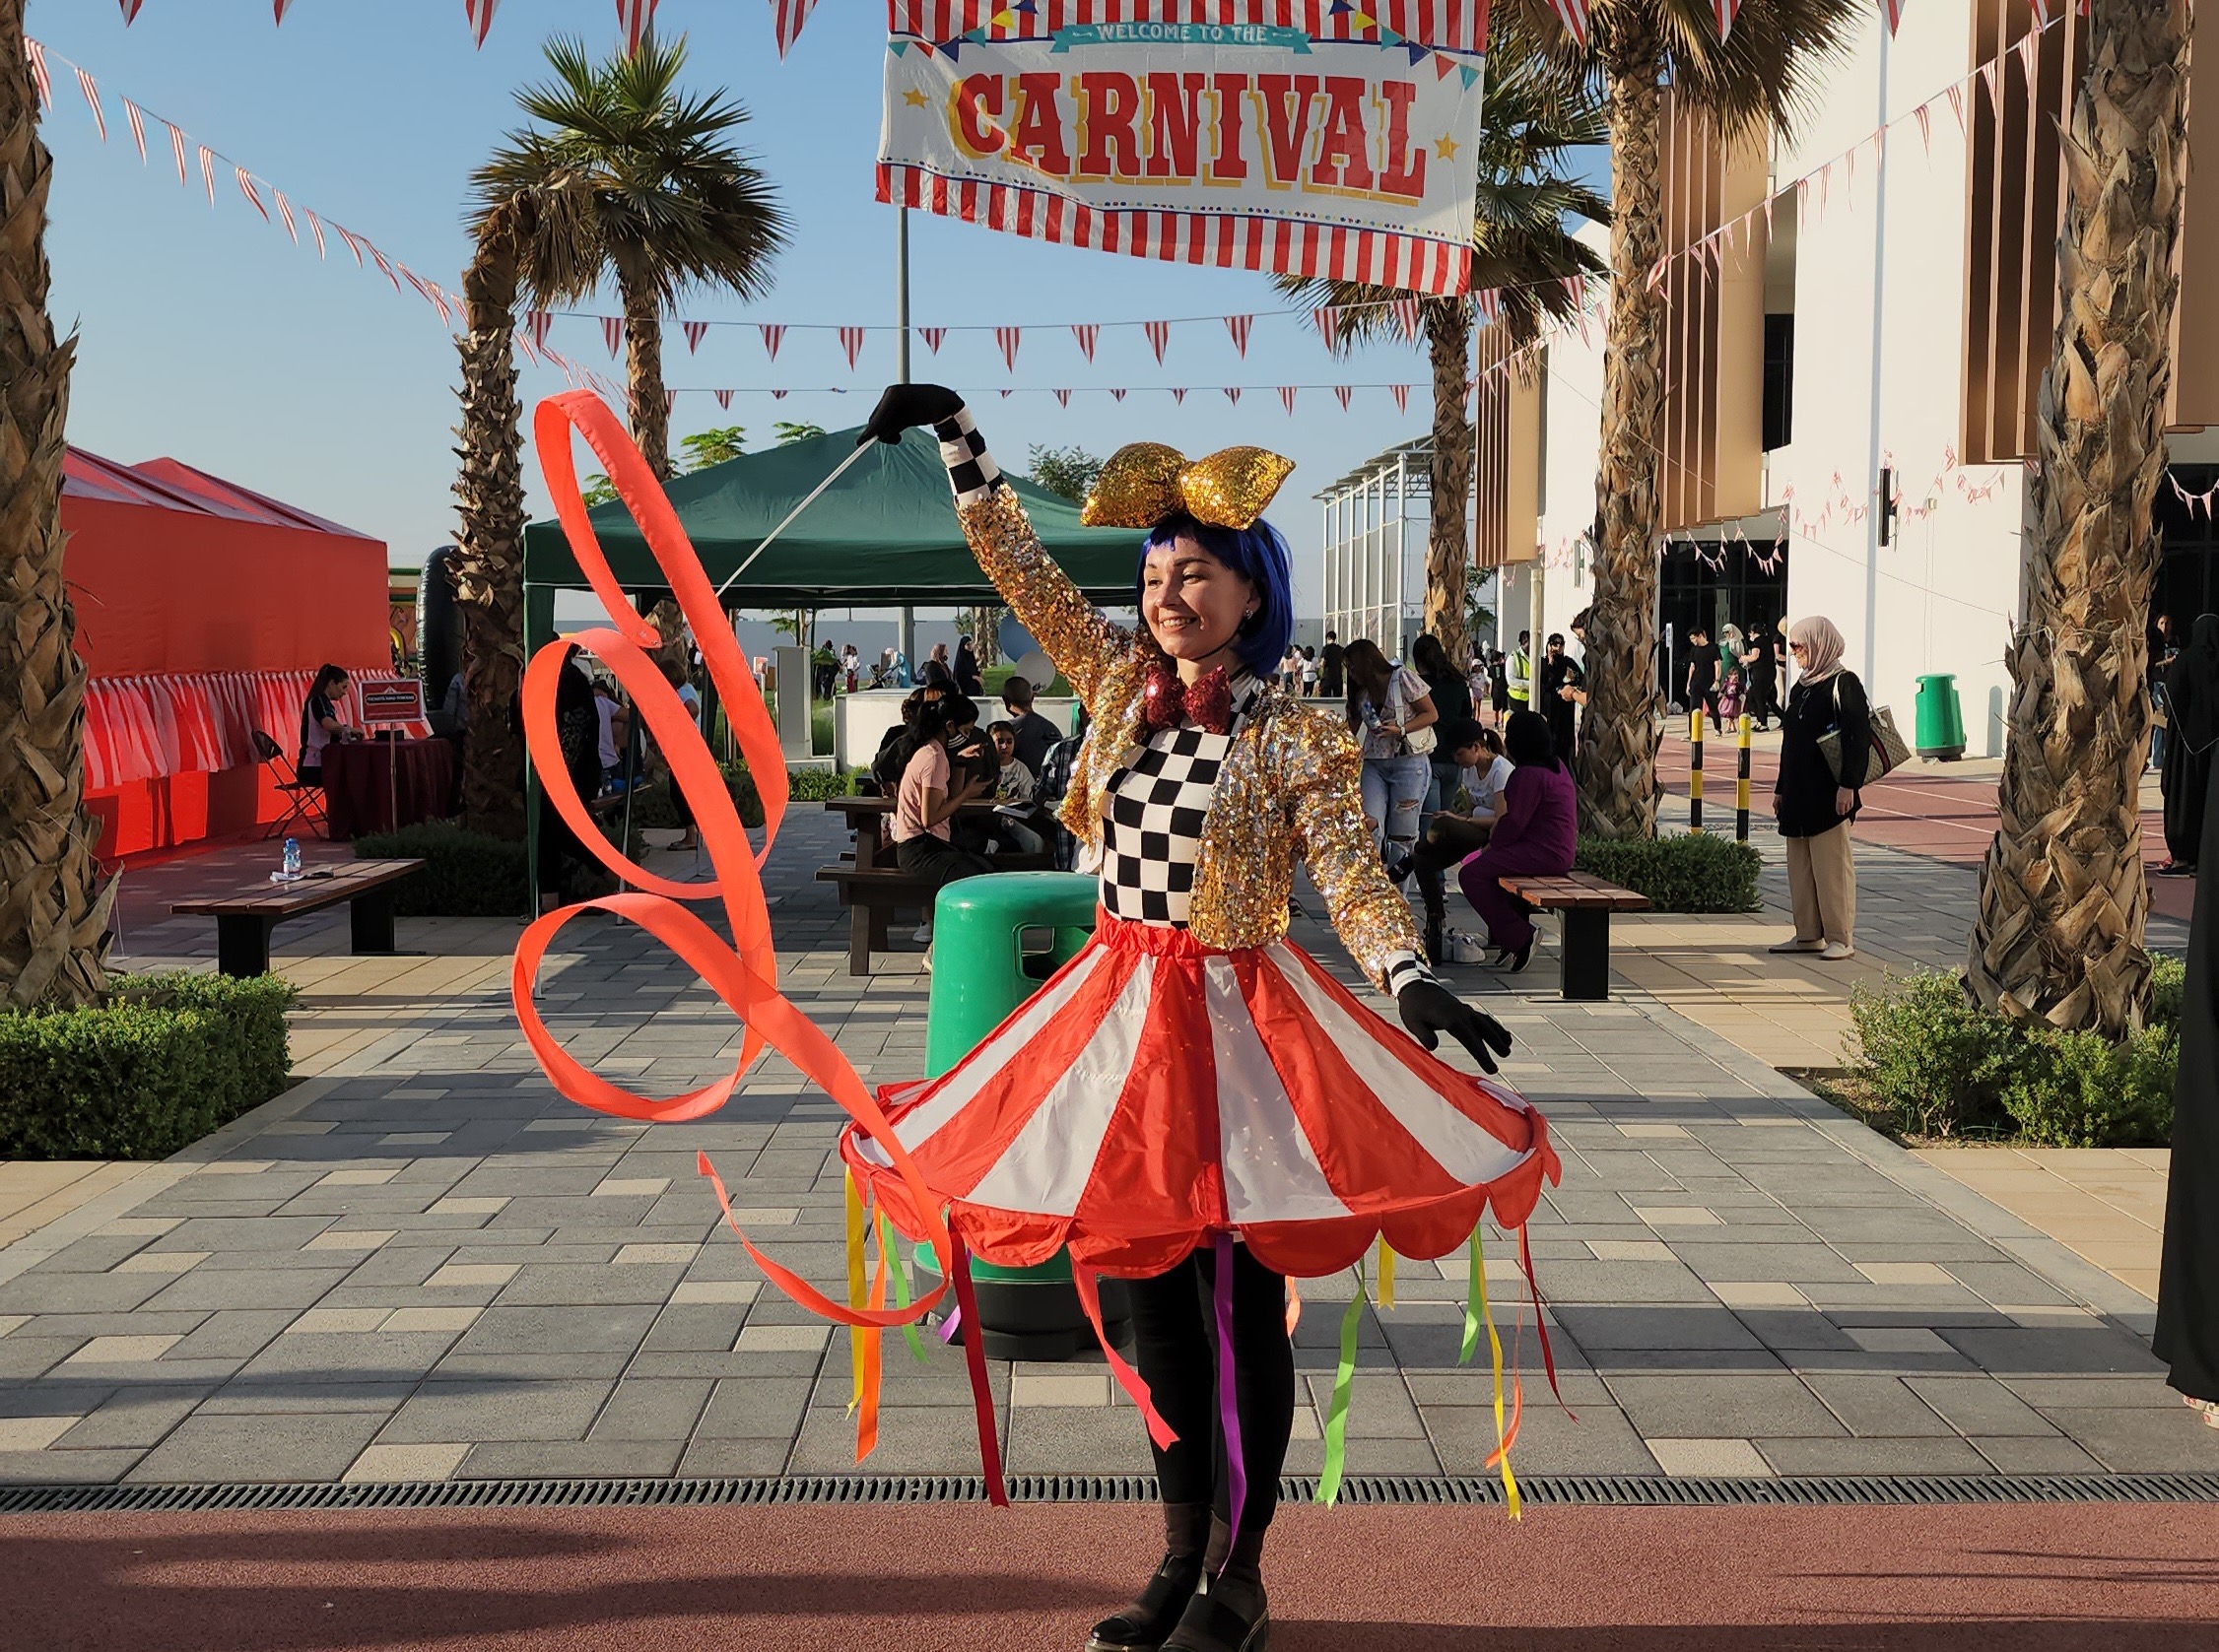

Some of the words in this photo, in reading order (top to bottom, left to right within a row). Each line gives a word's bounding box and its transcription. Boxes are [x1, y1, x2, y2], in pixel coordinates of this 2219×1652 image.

[1096, 24, 1192, 41] WELCOME
[1198, 25, 1225, 41] TO
[1231, 26, 1268, 42] THE
[954, 71, 1428, 200] CARNIVAL
